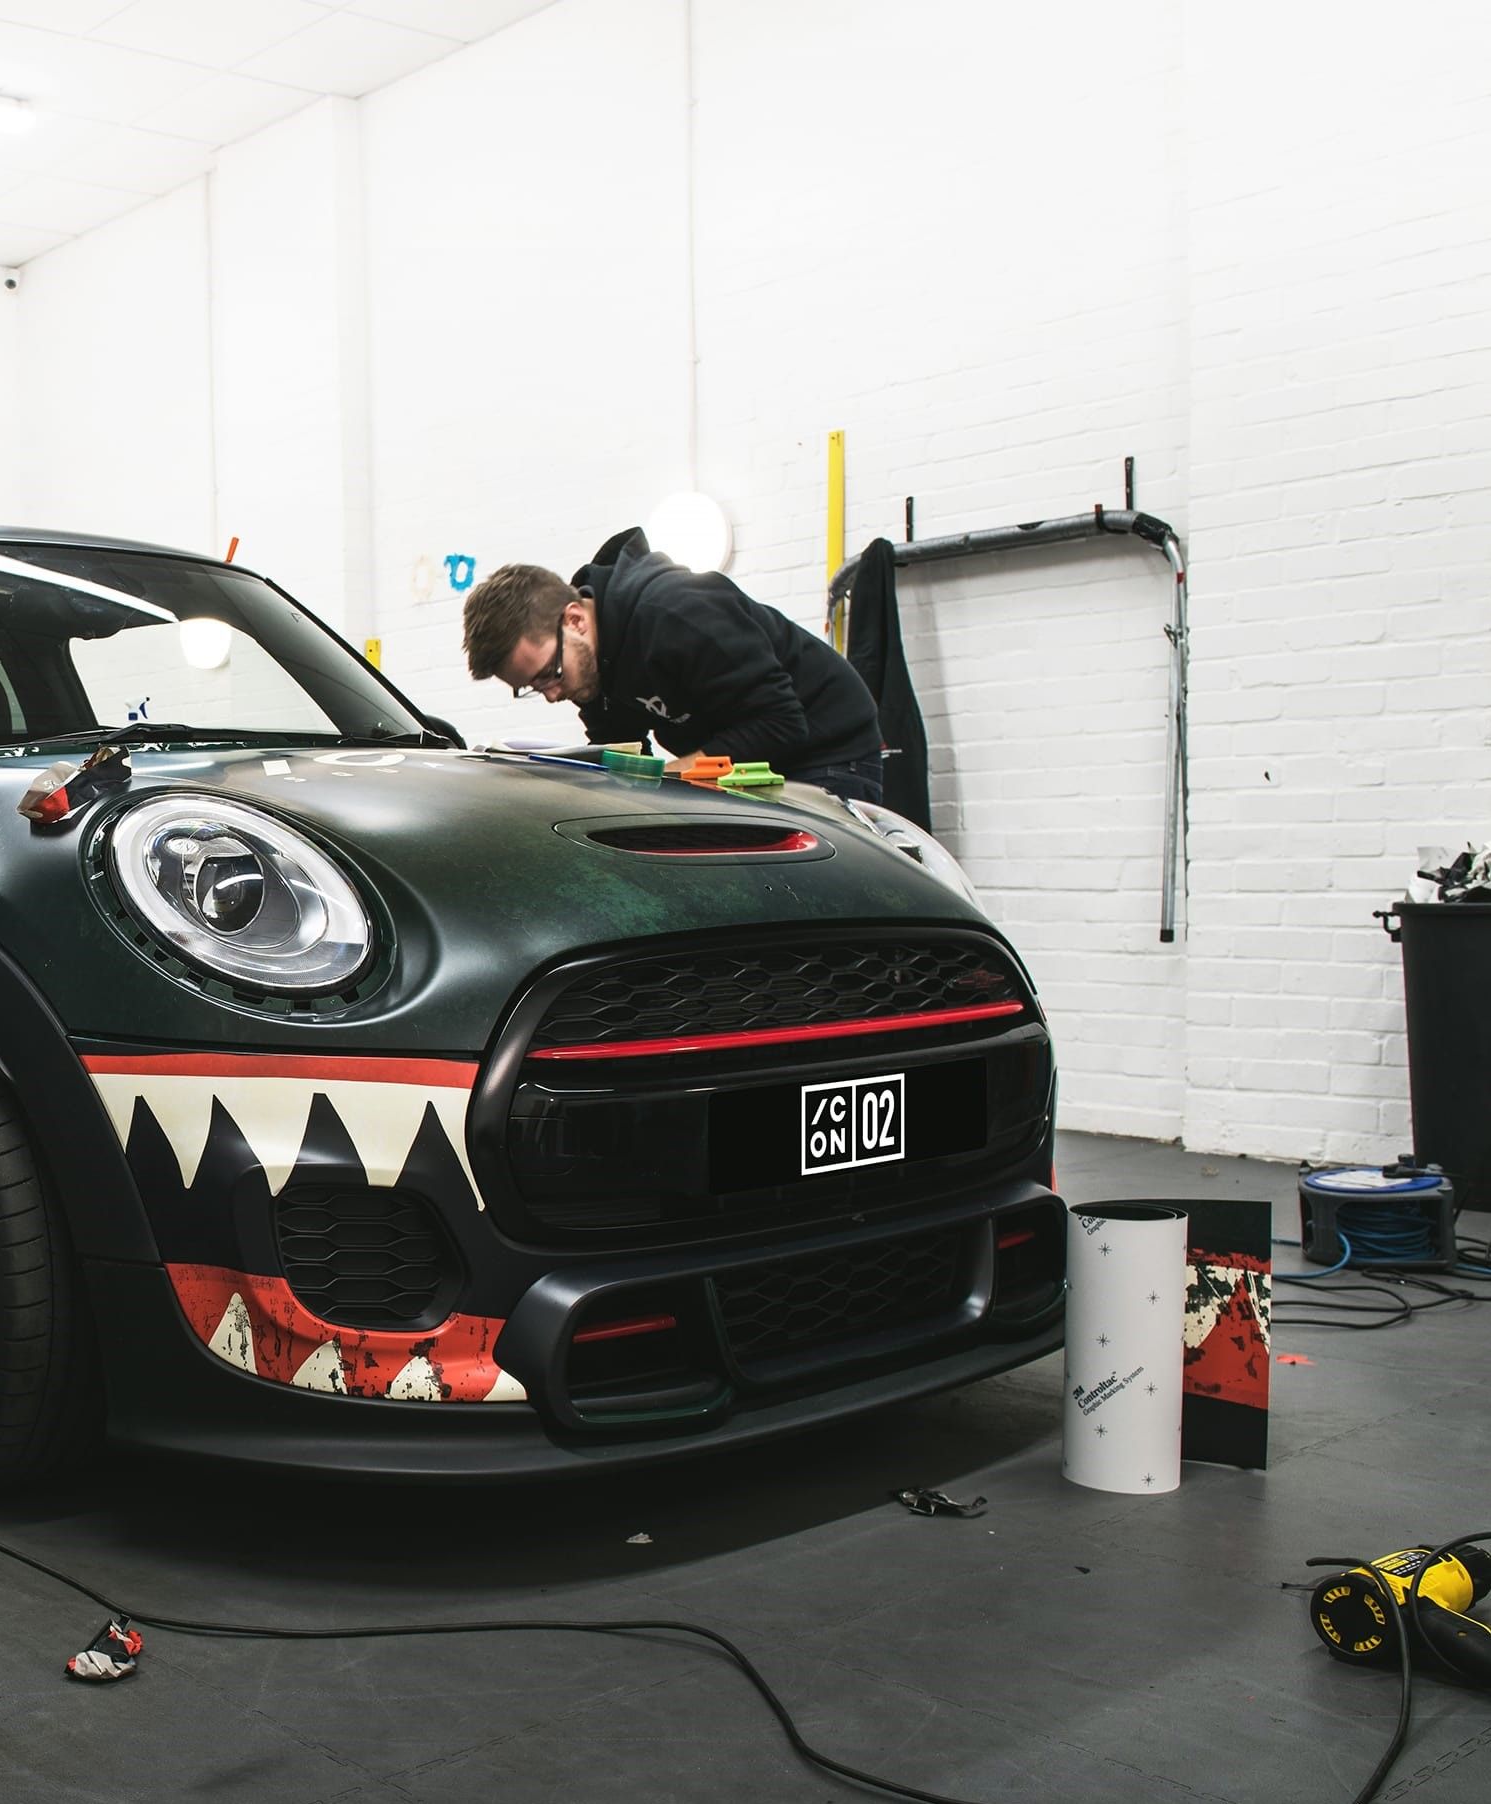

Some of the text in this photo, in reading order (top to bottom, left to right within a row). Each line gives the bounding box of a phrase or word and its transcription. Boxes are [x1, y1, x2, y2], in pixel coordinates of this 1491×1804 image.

[862, 1089, 895, 1150] 02
[1122, 1366, 1144, 1384] System
[1072, 1385, 1085, 1400] 3M
